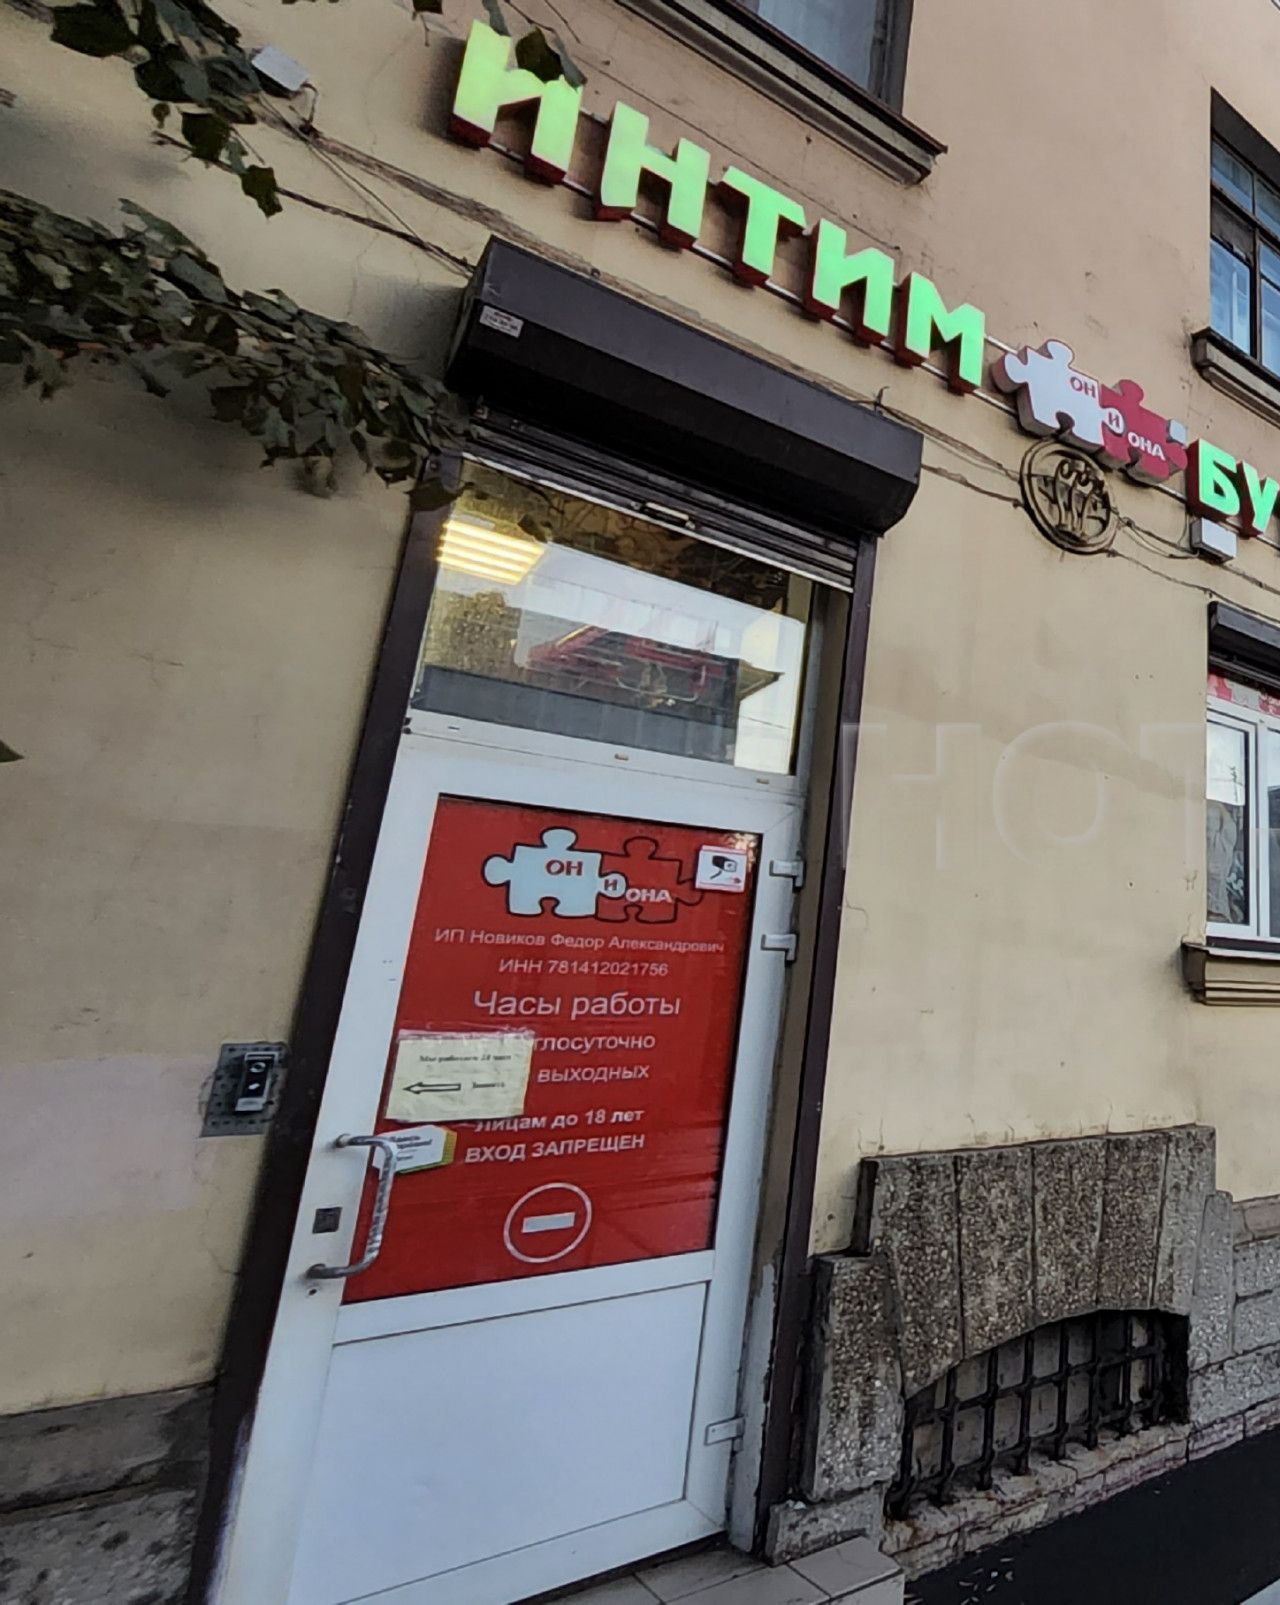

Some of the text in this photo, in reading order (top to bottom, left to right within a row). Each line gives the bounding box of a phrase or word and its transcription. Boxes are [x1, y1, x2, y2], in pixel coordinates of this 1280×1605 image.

[453, 18, 985, 388] ИНТИМ
[1069, 376, 1097, 398] ОН
[1127, 432, 1166, 461] ОНА
[545, 859, 583, 876] ОН
[625, 887, 673, 903] ОНА
[434, 928, 724, 953] ИП Новиков Федор Александрович
[498, 959, 669, 976] ИНН 781412021756
[473, 990, 681, 1021] Часы работы
[533, 1035, 656, 1054] глосуточно
[551, 1113, 578, 1129] до
[584, 1108, 606, 1125] 18
[610, 1109, 645, 1123] лет
[464, 1134, 646, 1163] ВХОД ЗАПРЕЩЕН
